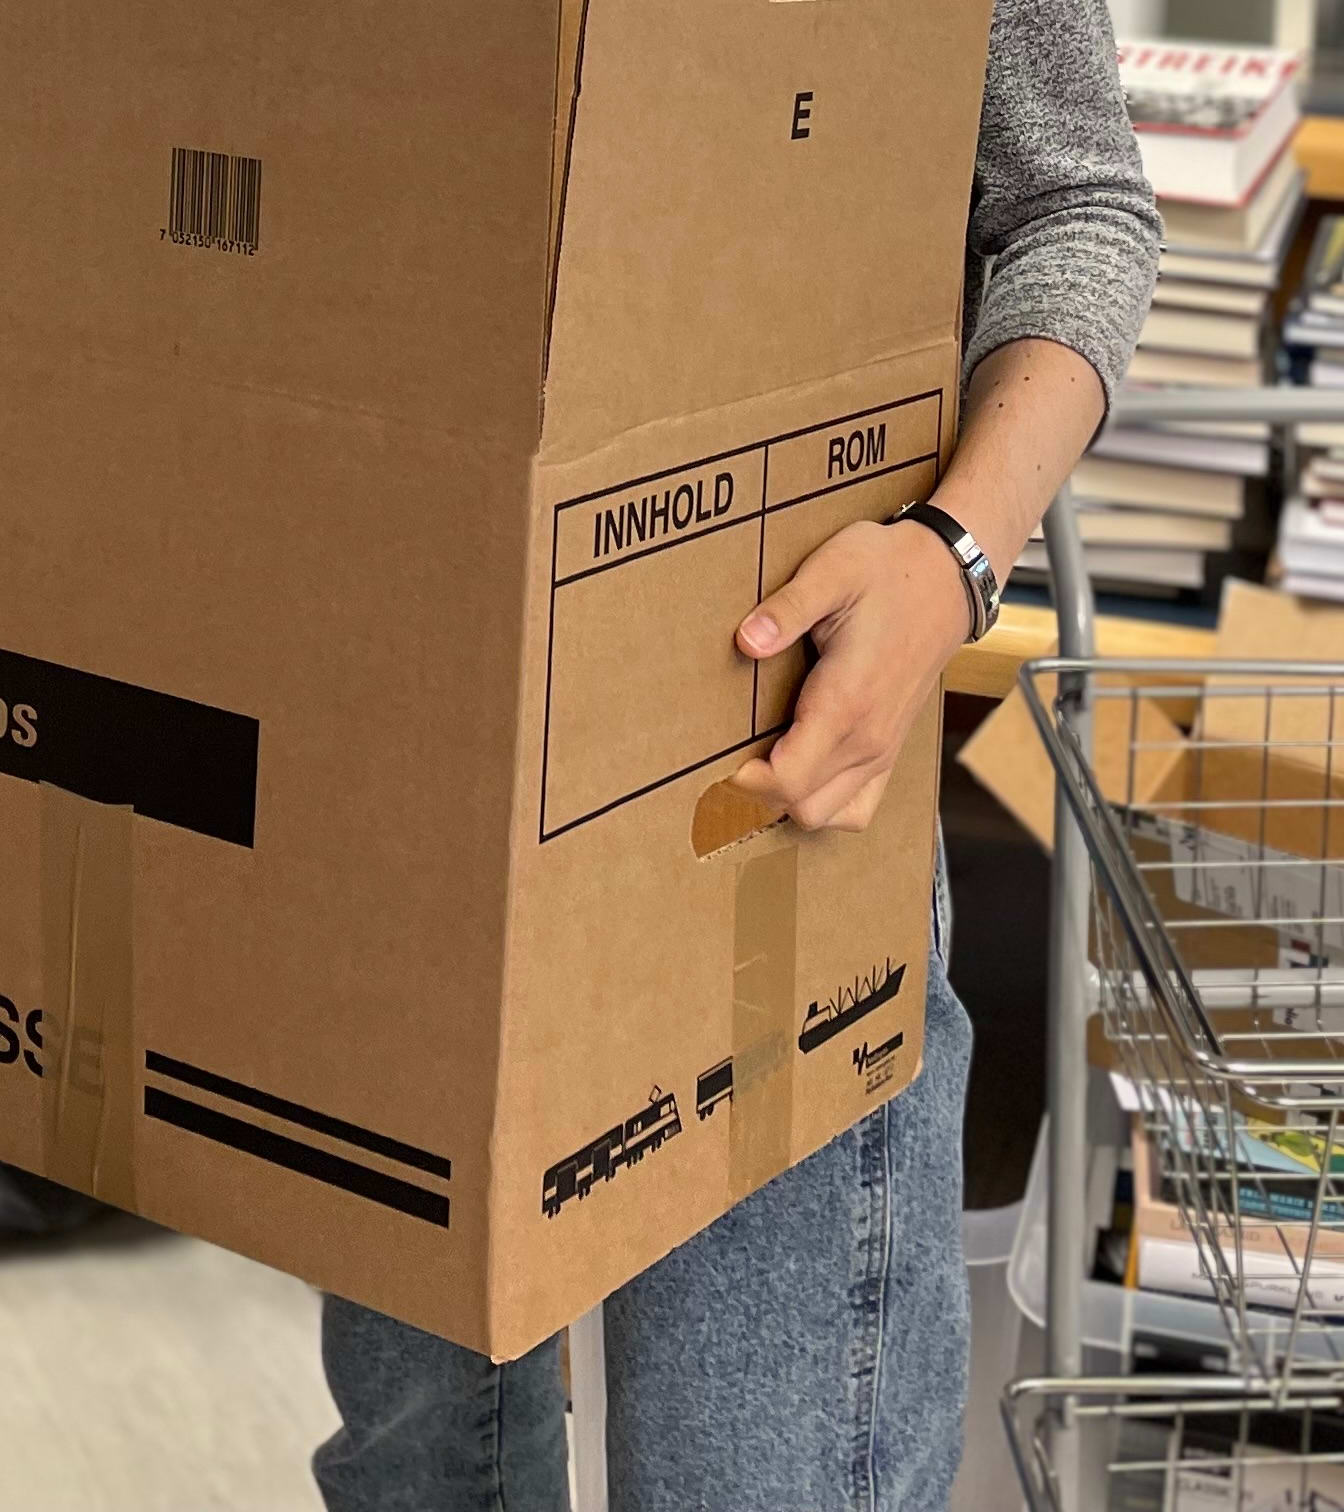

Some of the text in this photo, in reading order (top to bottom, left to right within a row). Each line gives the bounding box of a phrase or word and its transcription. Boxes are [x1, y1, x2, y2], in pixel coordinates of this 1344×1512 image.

[791, 92, 813, 140] E
[827, 424, 886, 479] ROM
[592, 472, 734, 559] INNHOLD
